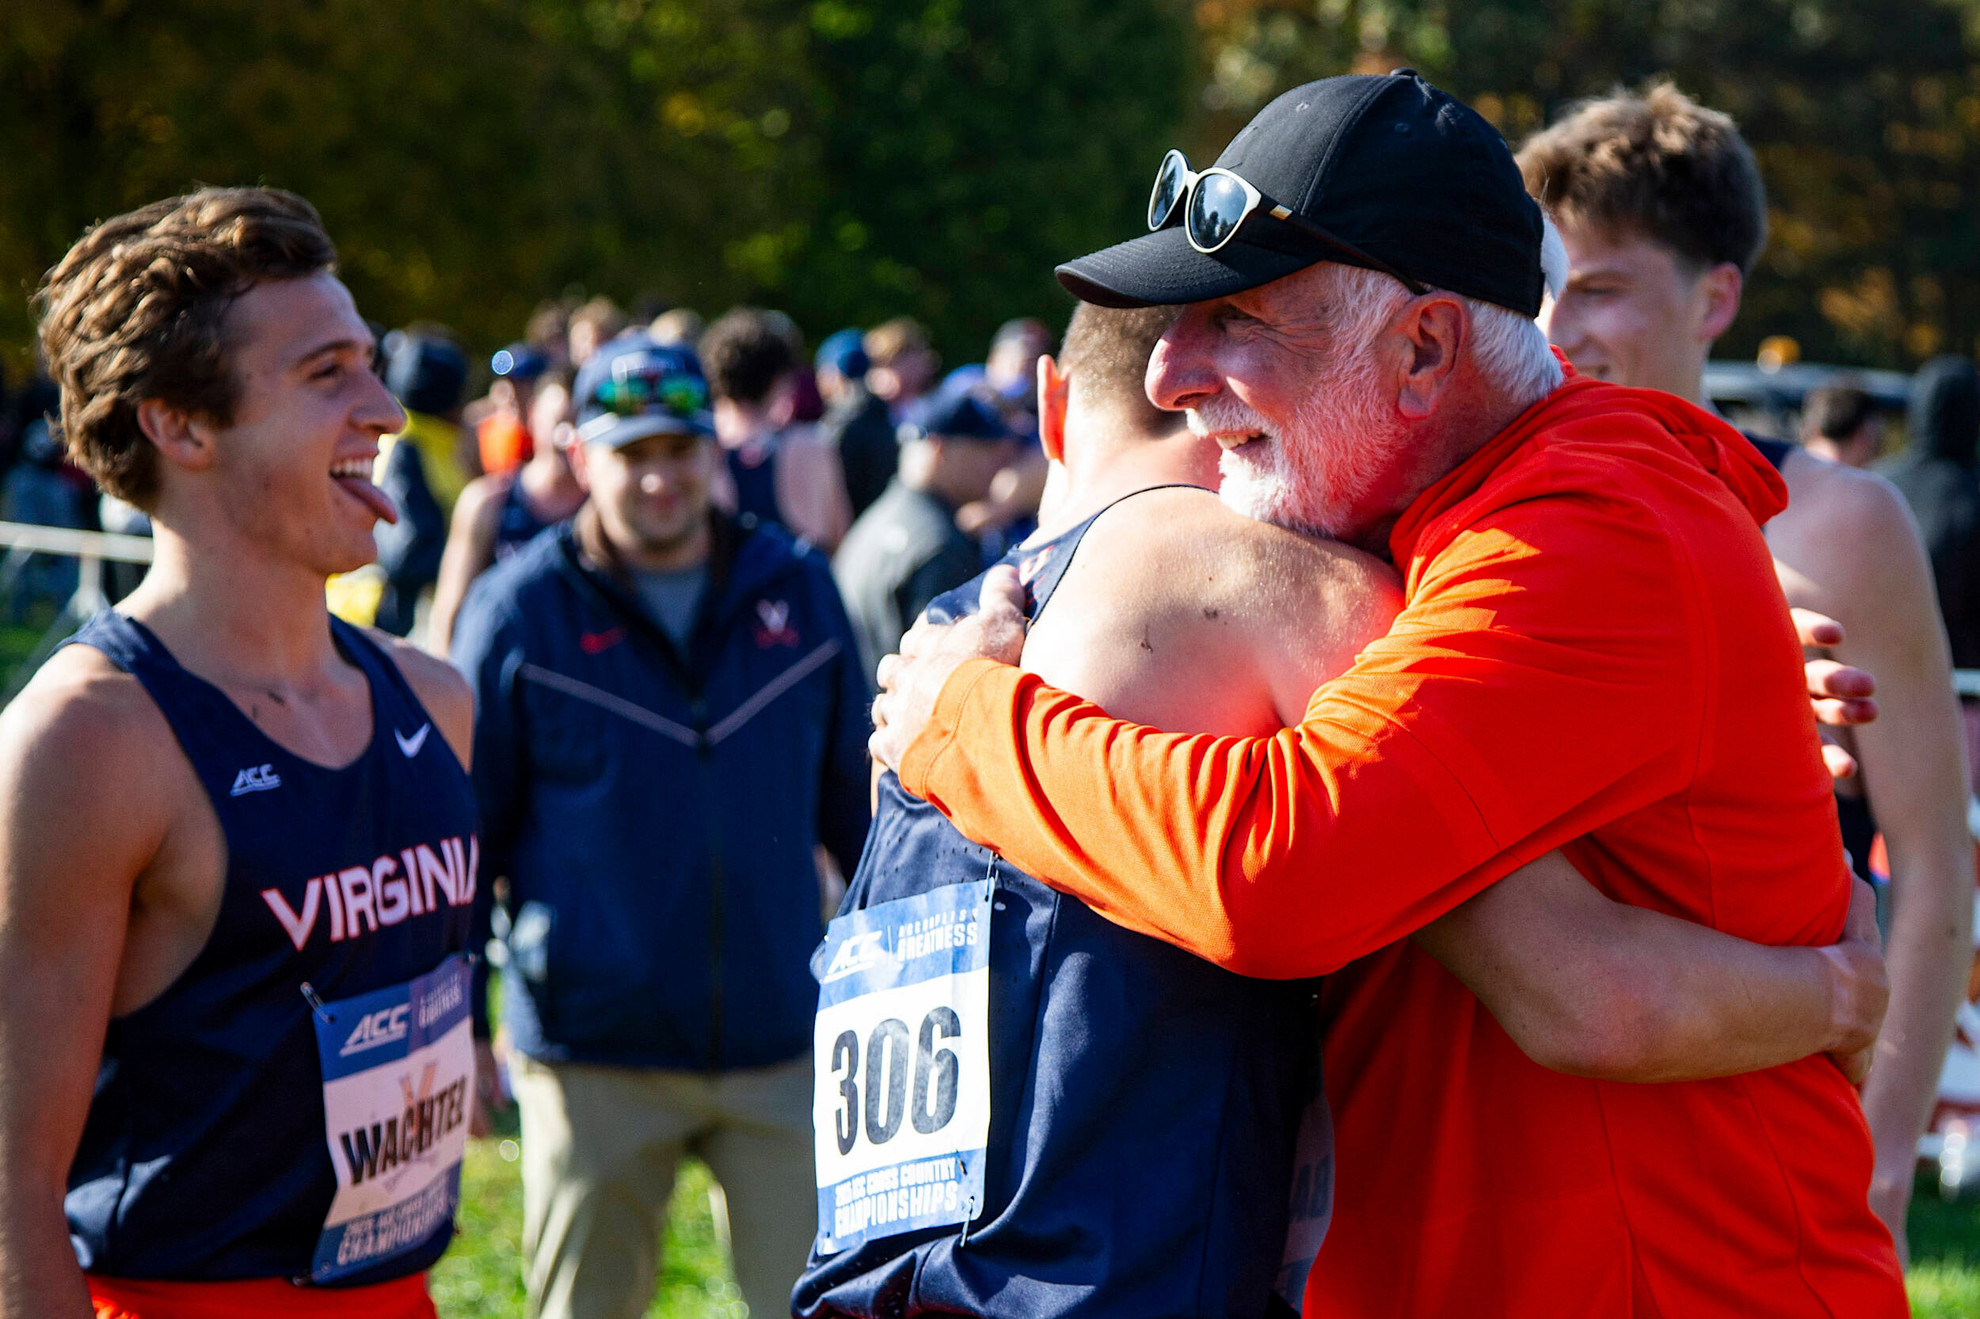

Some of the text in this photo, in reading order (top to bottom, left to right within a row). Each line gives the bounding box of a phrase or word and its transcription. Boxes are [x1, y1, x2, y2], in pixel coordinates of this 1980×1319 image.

[231, 763, 281, 795] ACC
[823, 931, 883, 984] ACC
[897, 922, 978, 961] GREATNESS
[339, 1002, 412, 1057] ACC
[831, 1006, 961, 1156] 306
[900, 1157, 956, 1188] COUNTRY
[835, 1180, 958, 1239] CHAMPIONSHIPS
